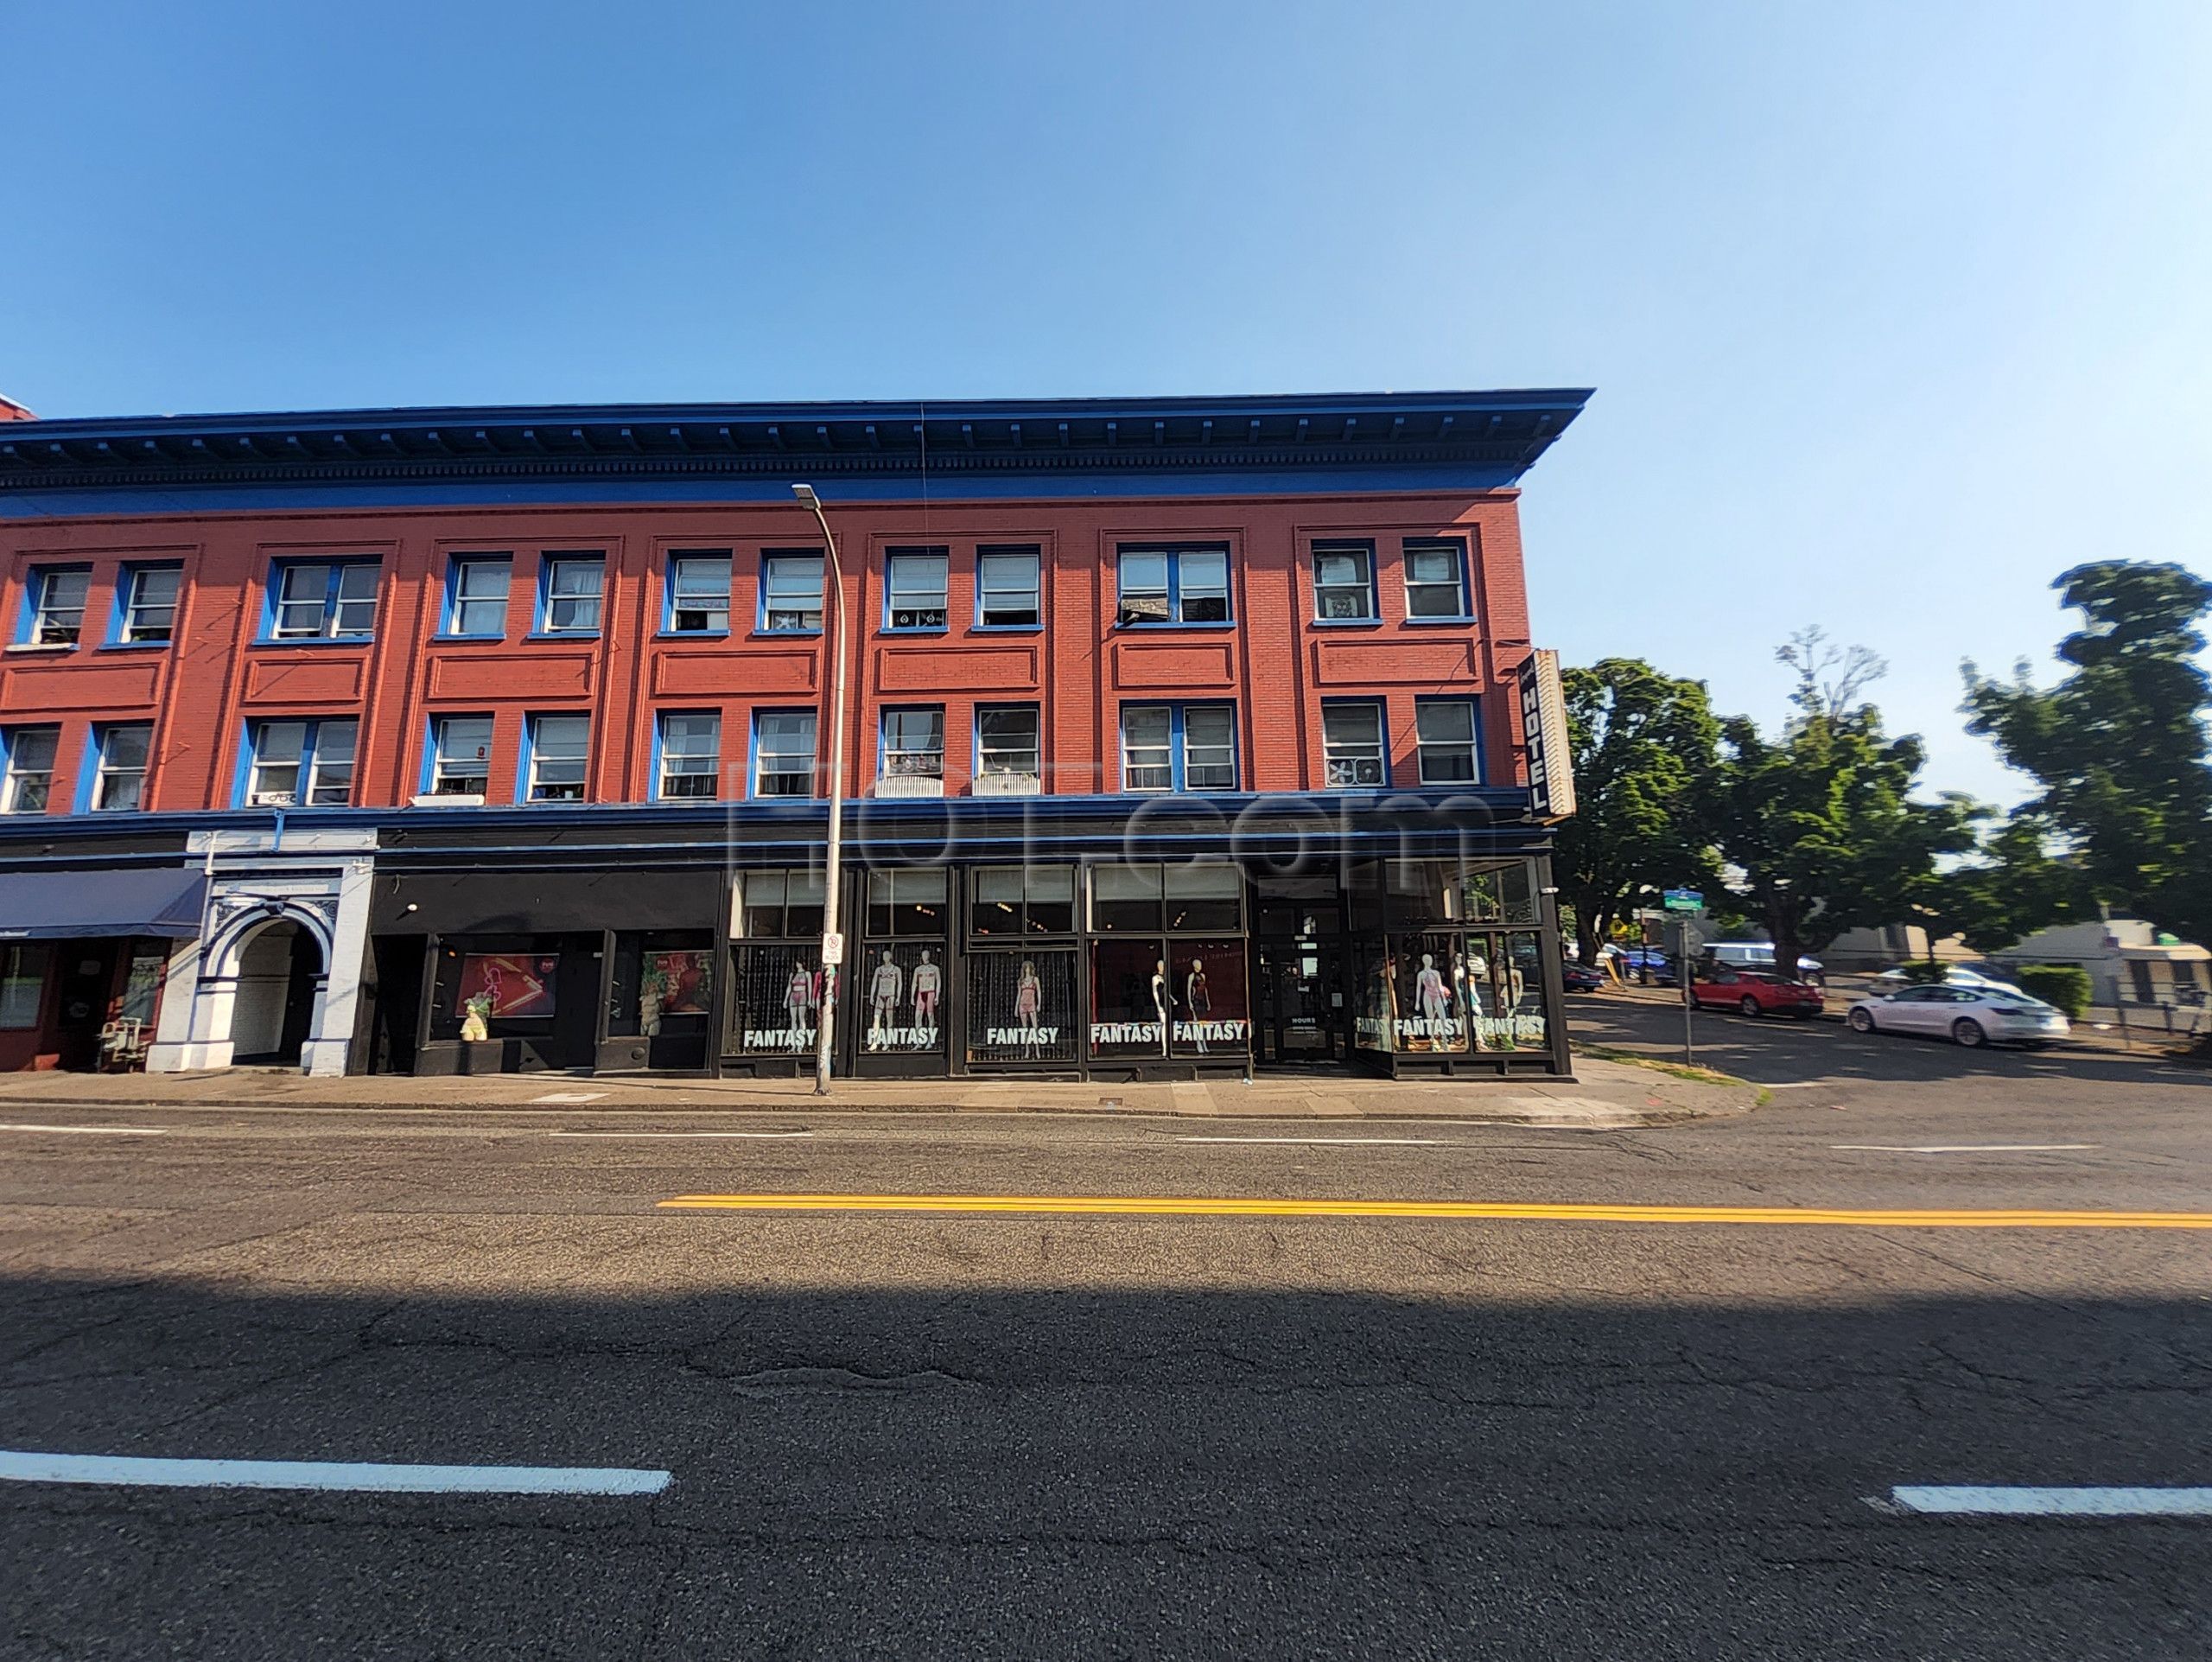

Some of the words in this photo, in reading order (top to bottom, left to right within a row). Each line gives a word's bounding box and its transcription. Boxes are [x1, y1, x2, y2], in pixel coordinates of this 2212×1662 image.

[1522, 687, 1548, 811] HOTEL
[987, 1027, 1058, 1045] FANTASY
[1090, 1024, 1163, 1043] FANTASY
[1173, 1023, 1244, 1042] FANTASY
[1393, 1017, 1464, 1036] FANTASY
[744, 1028, 817, 1048] FANTASY
[867, 1027, 939, 1046] FANTASY
